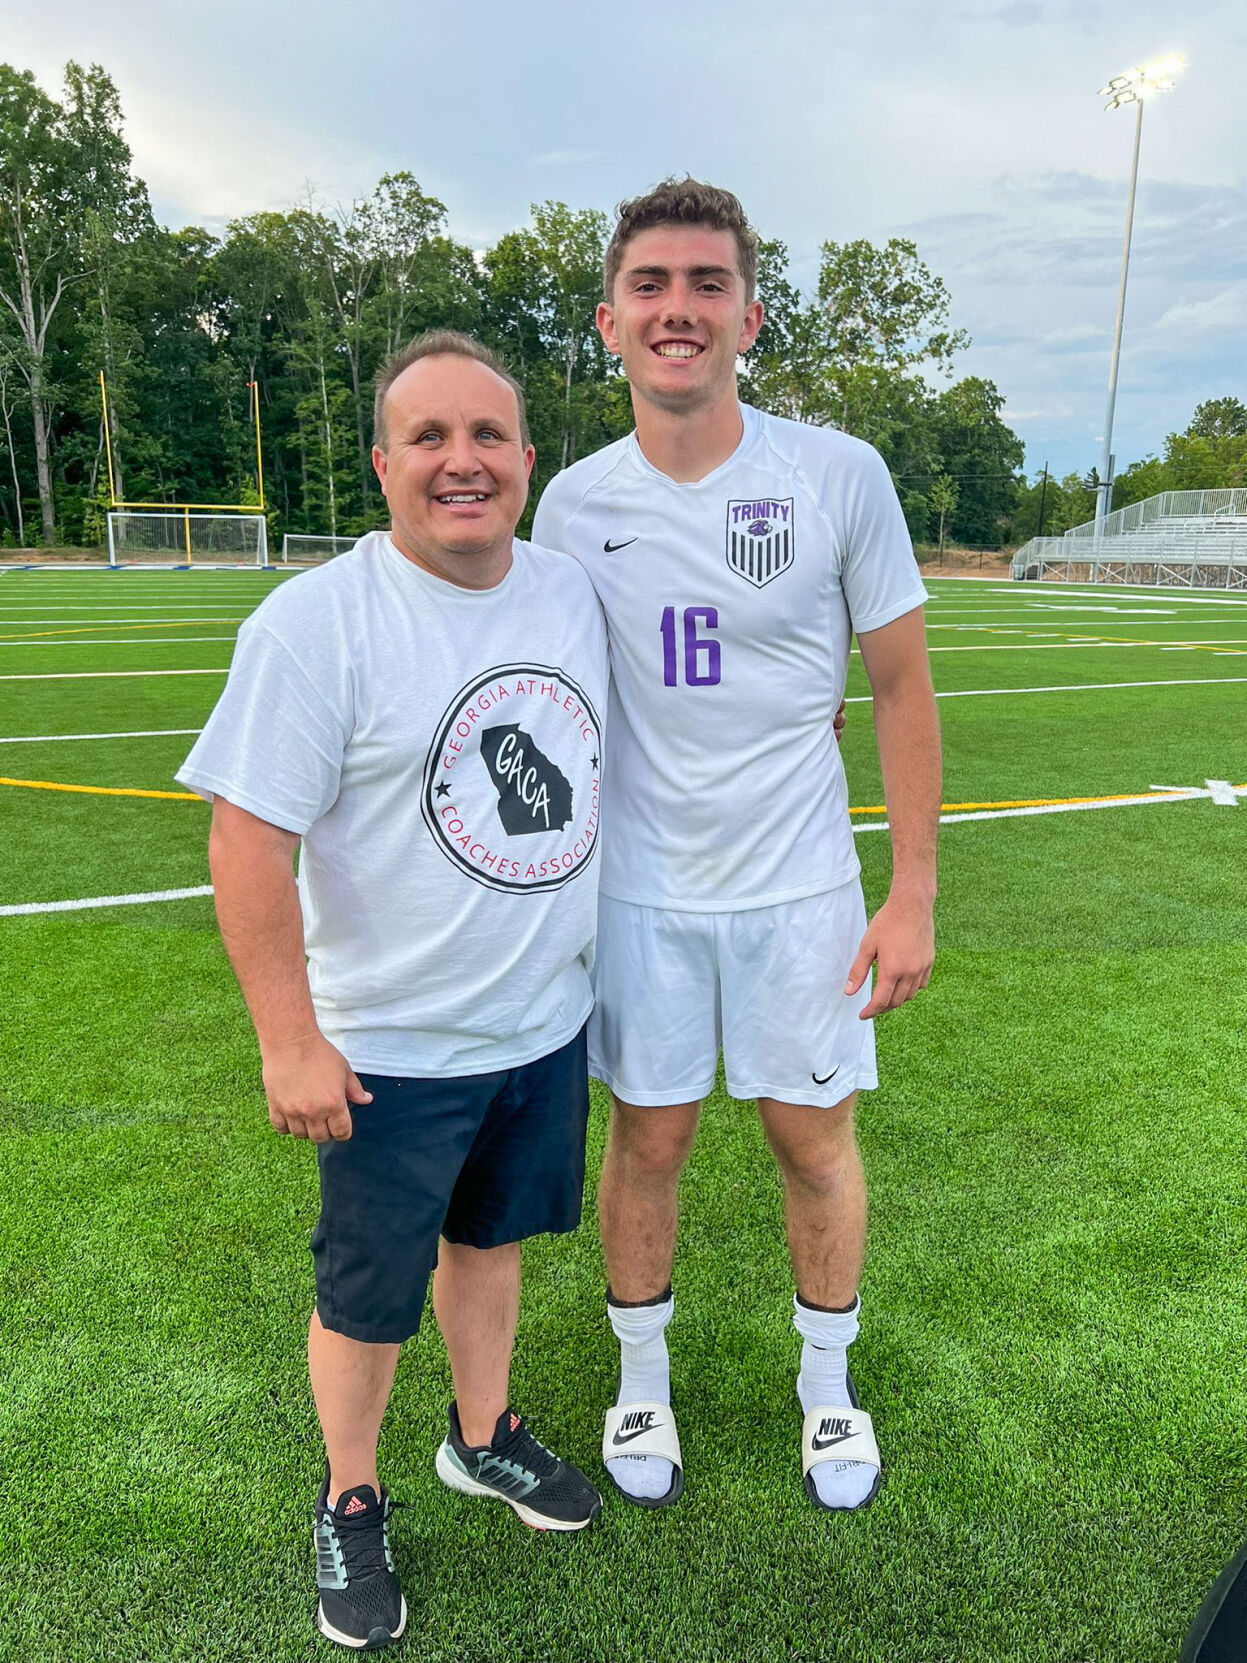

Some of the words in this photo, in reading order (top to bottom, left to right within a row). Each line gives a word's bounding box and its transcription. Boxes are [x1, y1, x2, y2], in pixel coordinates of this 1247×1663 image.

[732, 501, 790, 524] TRINITY
[660, 606, 721, 687] 16
[443, 684, 510, 770] GEORGIA
[515, 679, 595, 742] ATHLETIC
[495, 733, 551, 829] GACA
[441, 805, 521, 878] COACHES
[524, 779, 600, 879] ASSOCIATION
[620, 1411, 656, 1431] NIKE
[818, 1418, 853, 1436] NIKE
